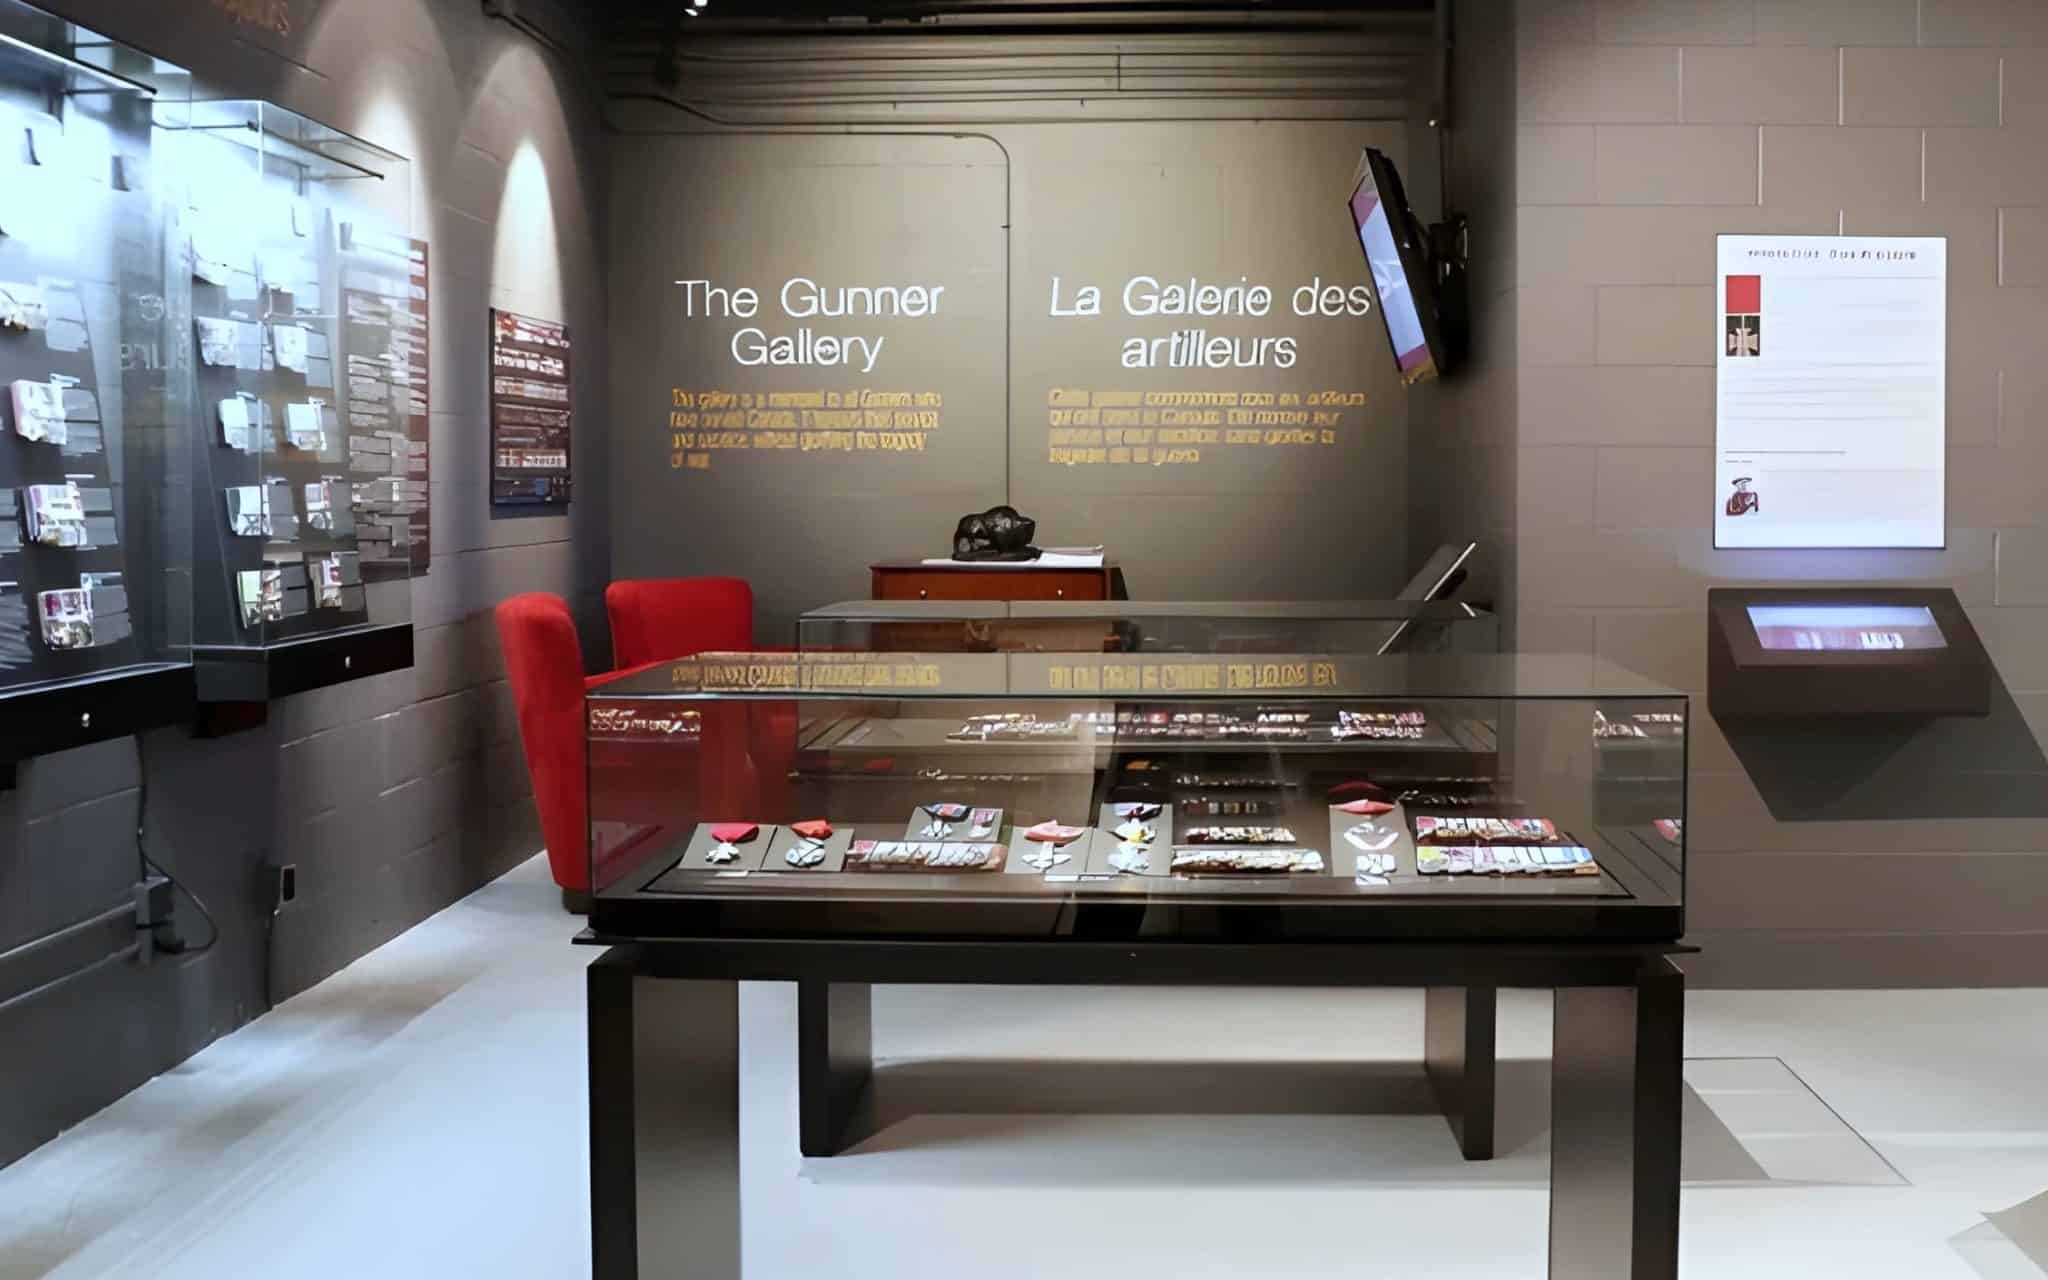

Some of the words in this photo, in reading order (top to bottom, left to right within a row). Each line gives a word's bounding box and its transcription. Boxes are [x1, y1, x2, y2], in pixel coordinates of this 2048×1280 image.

[675, 279, 758, 317] The
[780, 278, 944, 317] Gunner
[1050, 277, 1101, 316] La
[1122, 275, 1273, 316] Galerie
[1292, 276, 1371, 316] des
[731, 328, 884, 373] Gallery
[1121, 329, 1297, 368] artilleurs
